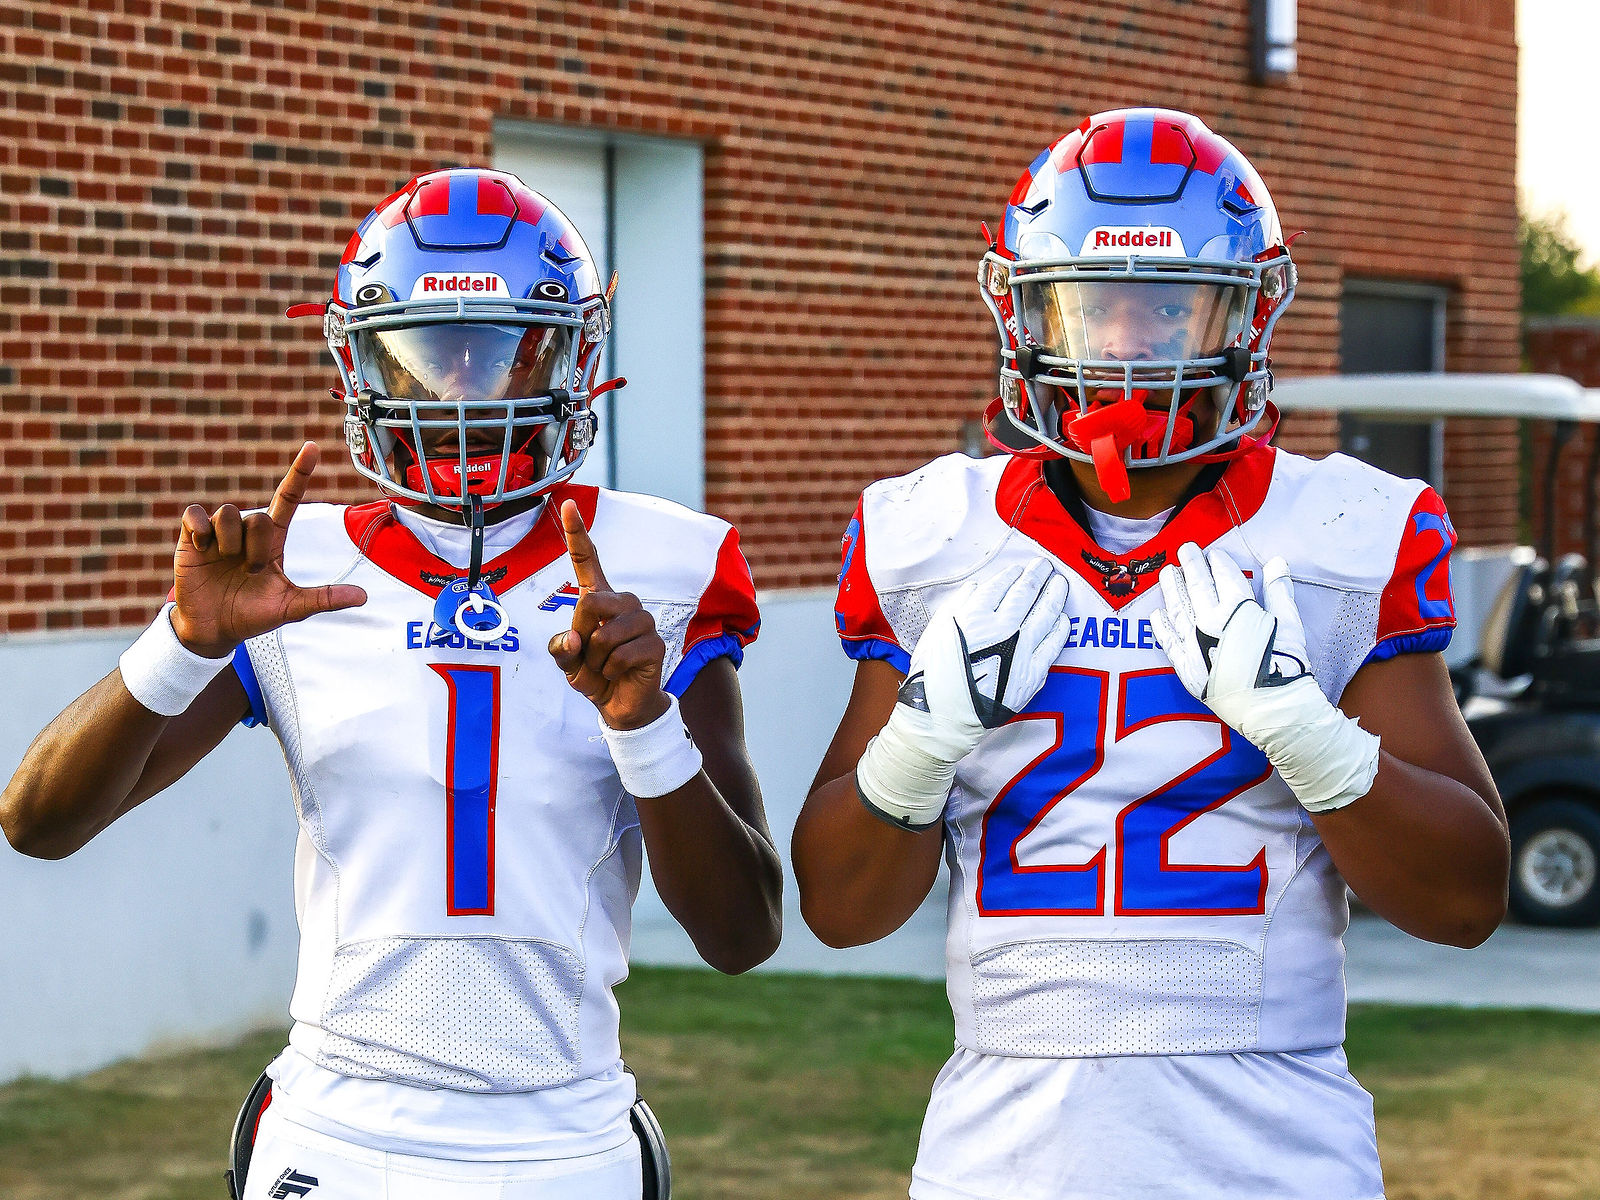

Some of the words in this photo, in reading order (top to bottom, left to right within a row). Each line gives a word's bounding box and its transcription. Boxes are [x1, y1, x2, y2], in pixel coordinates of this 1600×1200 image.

[1095, 230, 1172, 247] Riddell
[423, 276, 498, 292] Riddell
[453, 462, 492, 474] Rddell
[1089, 558, 1110, 573] WINGS
[1134, 562, 1150, 574] UP
[1063, 616, 1163, 650] EAGLE
[426, 662, 501, 917] 1
[975, 665, 1269, 917] 22
